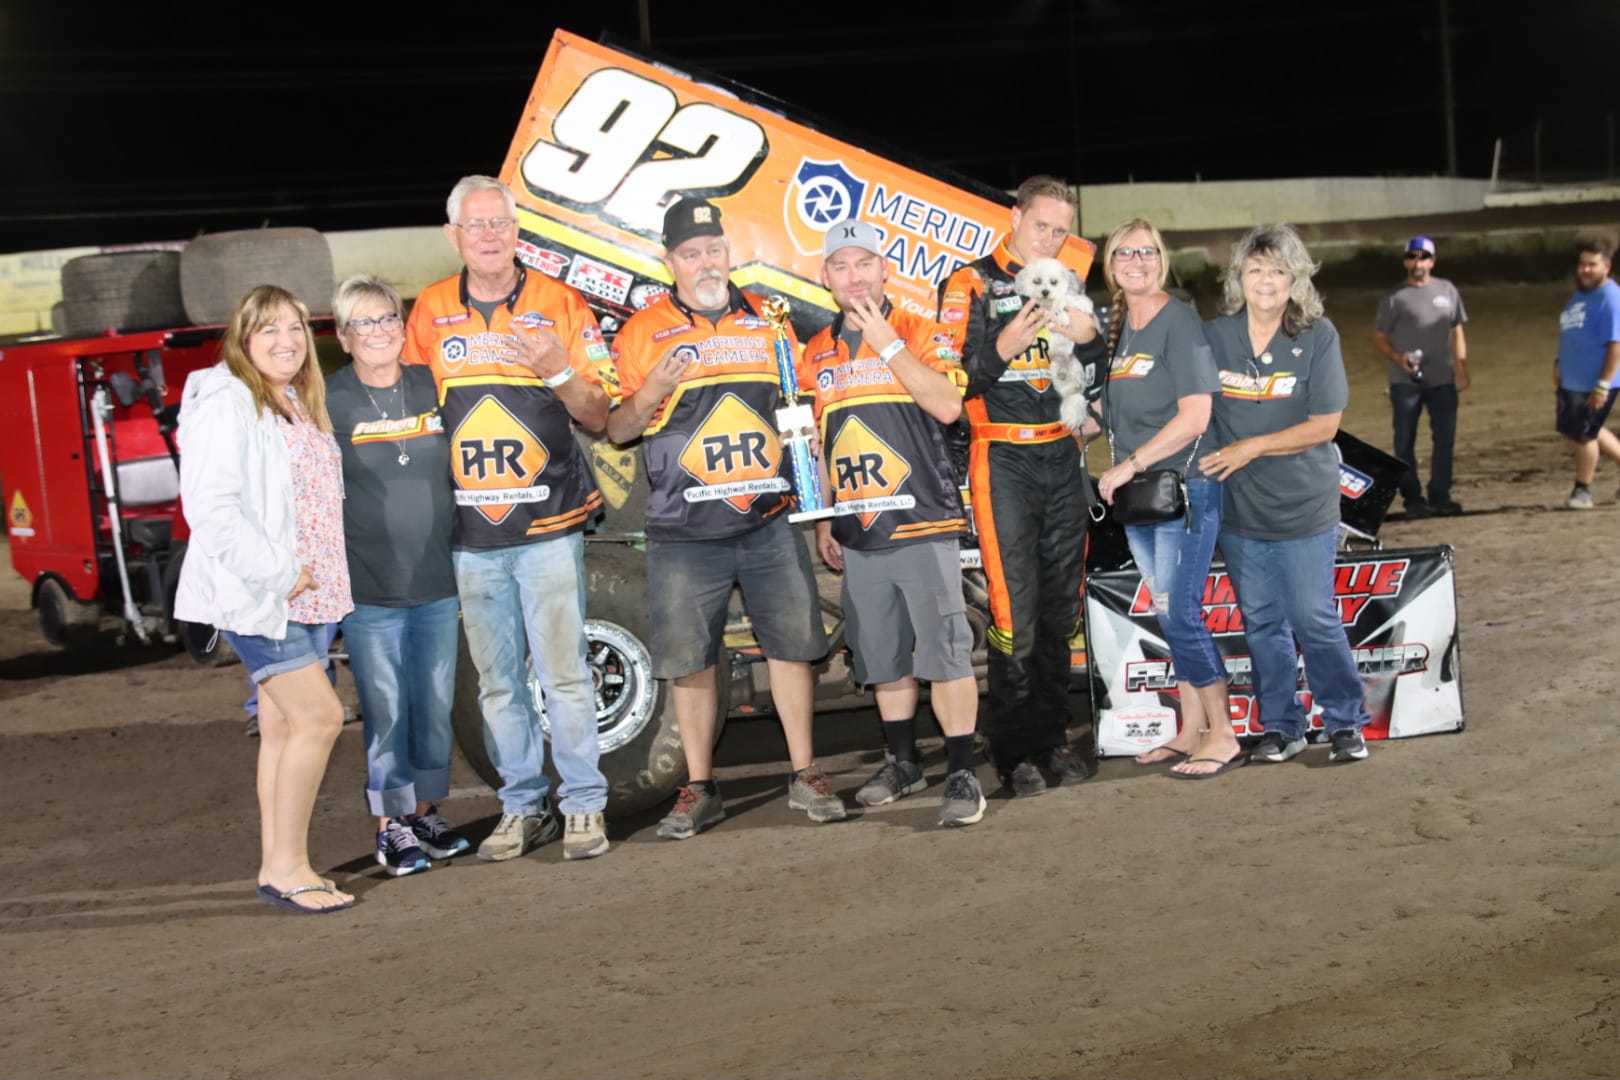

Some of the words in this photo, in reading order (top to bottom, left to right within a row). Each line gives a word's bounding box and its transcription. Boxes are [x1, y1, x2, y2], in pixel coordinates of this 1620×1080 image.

[521, 66, 768, 233] 92
[693, 205, 713, 224] 92
[869, 186, 993, 257] MERIDI
[579, 263, 629, 288] FK
[585, 277, 625, 296] ROD
[571, 279, 622, 302] ENDS
[702, 350, 770, 366] CAMERA
[836, 371, 895, 390] CAMERA
[460, 439, 527, 480] PHR
[703, 431, 770, 474] PHR
[835, 453, 889, 491] PHR
[467, 494, 500, 504] Highway
[714, 484, 747, 498] Highway
